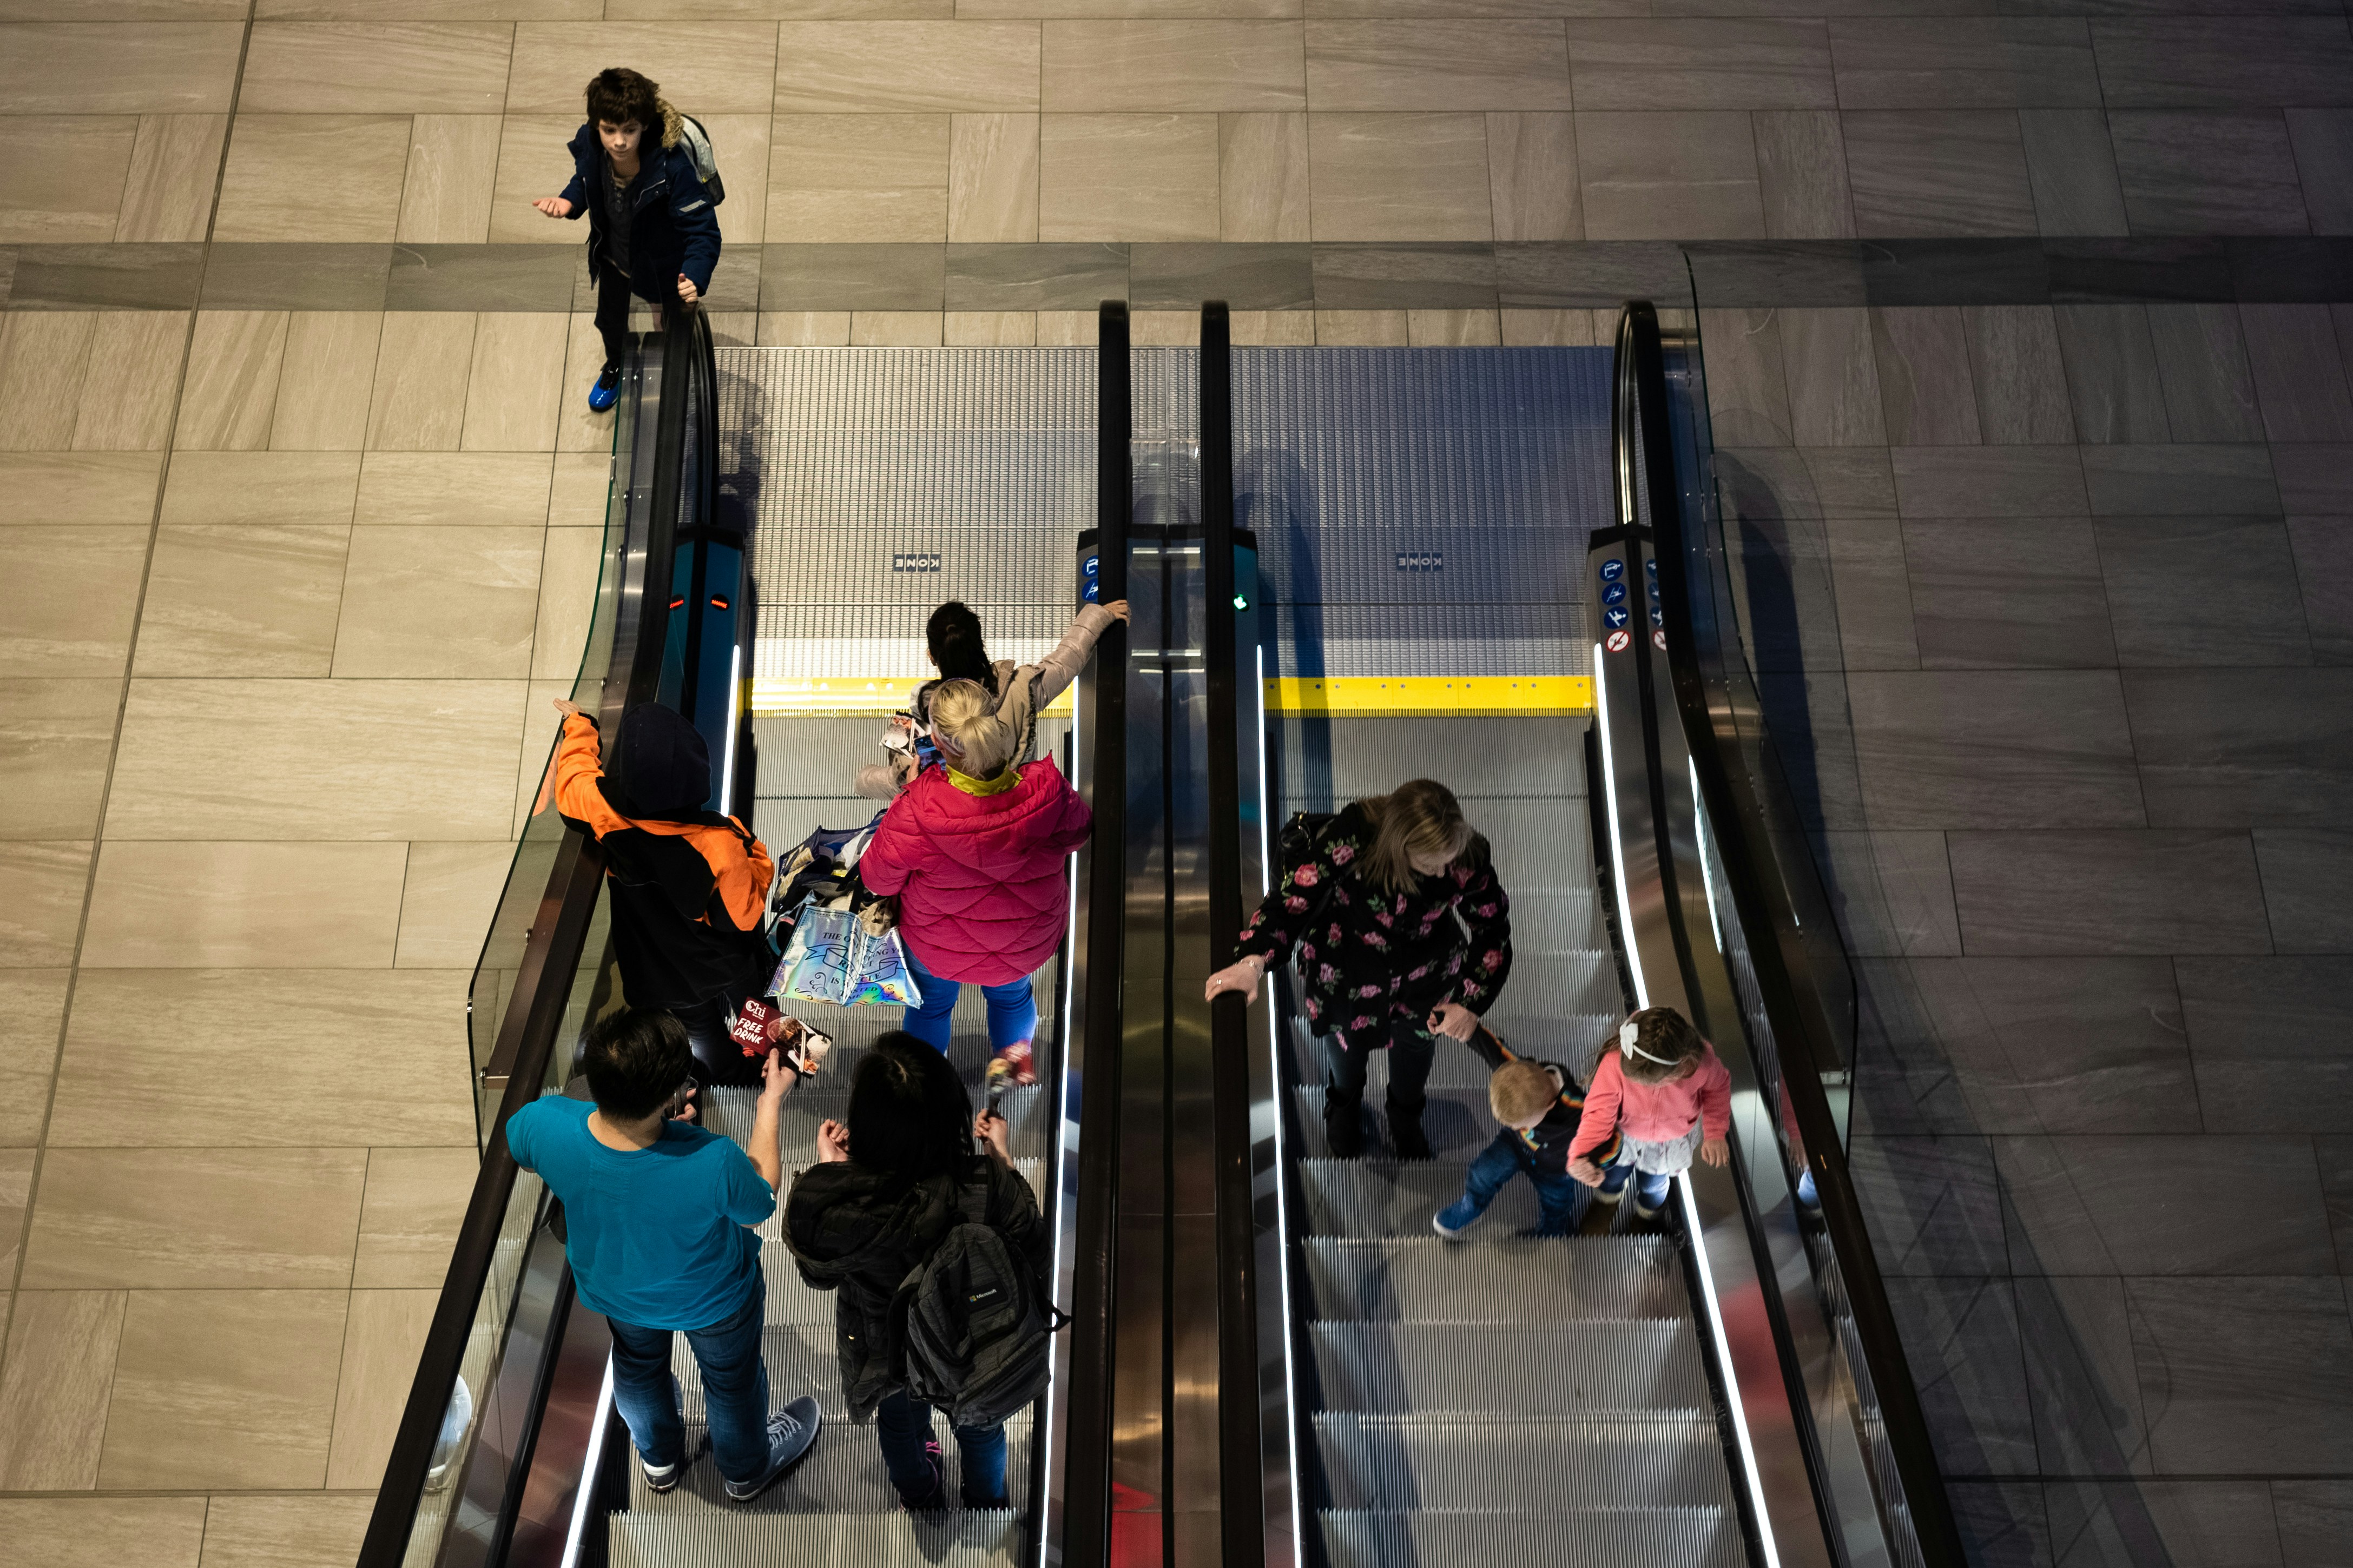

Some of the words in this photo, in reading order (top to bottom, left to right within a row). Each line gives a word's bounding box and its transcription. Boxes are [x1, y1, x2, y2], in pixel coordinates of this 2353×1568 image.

[894, 558, 940, 568] KONE
[1397, 556, 1442, 567] KONE
[823, 932, 842, 941] THE
[746, 1000, 766, 1018] Chi
[737, 1017, 763, 1033] FREE
[734, 1028, 763, 1044] DRINK
[976, 1288, 997, 1299] Microsoft
